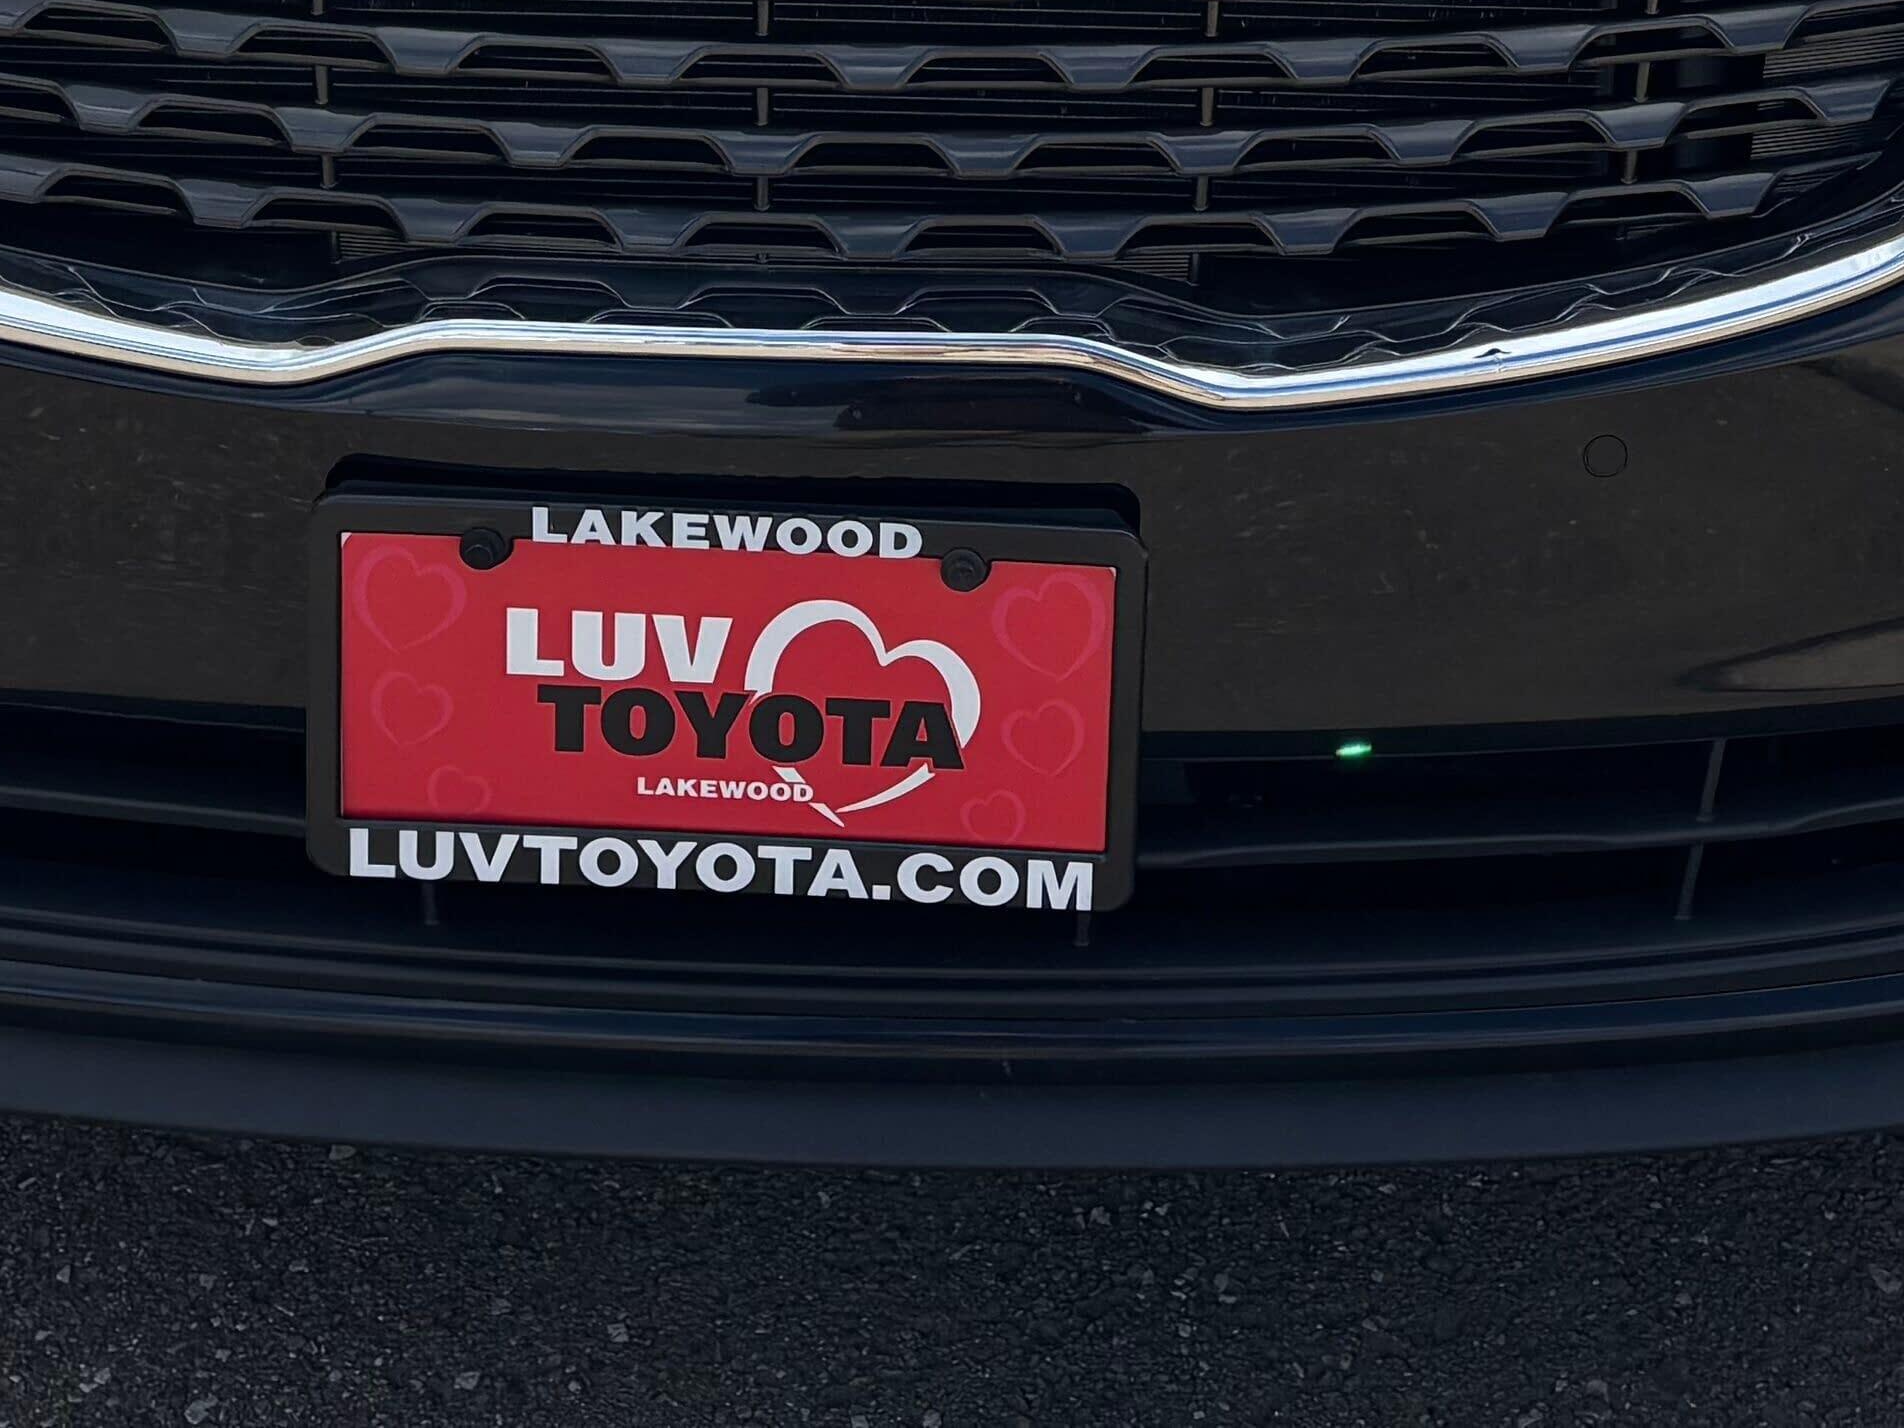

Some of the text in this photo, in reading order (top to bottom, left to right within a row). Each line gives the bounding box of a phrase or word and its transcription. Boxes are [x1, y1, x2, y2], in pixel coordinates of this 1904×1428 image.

[531, 506, 925, 560] LAKEWOOD
[504, 606, 735, 685] LUV
[536, 685, 967, 771] TOYOTA
[636, 776, 816, 805] LAKEWOOD
[348, 828, 1094, 913] LUVTOYOTA.COM
